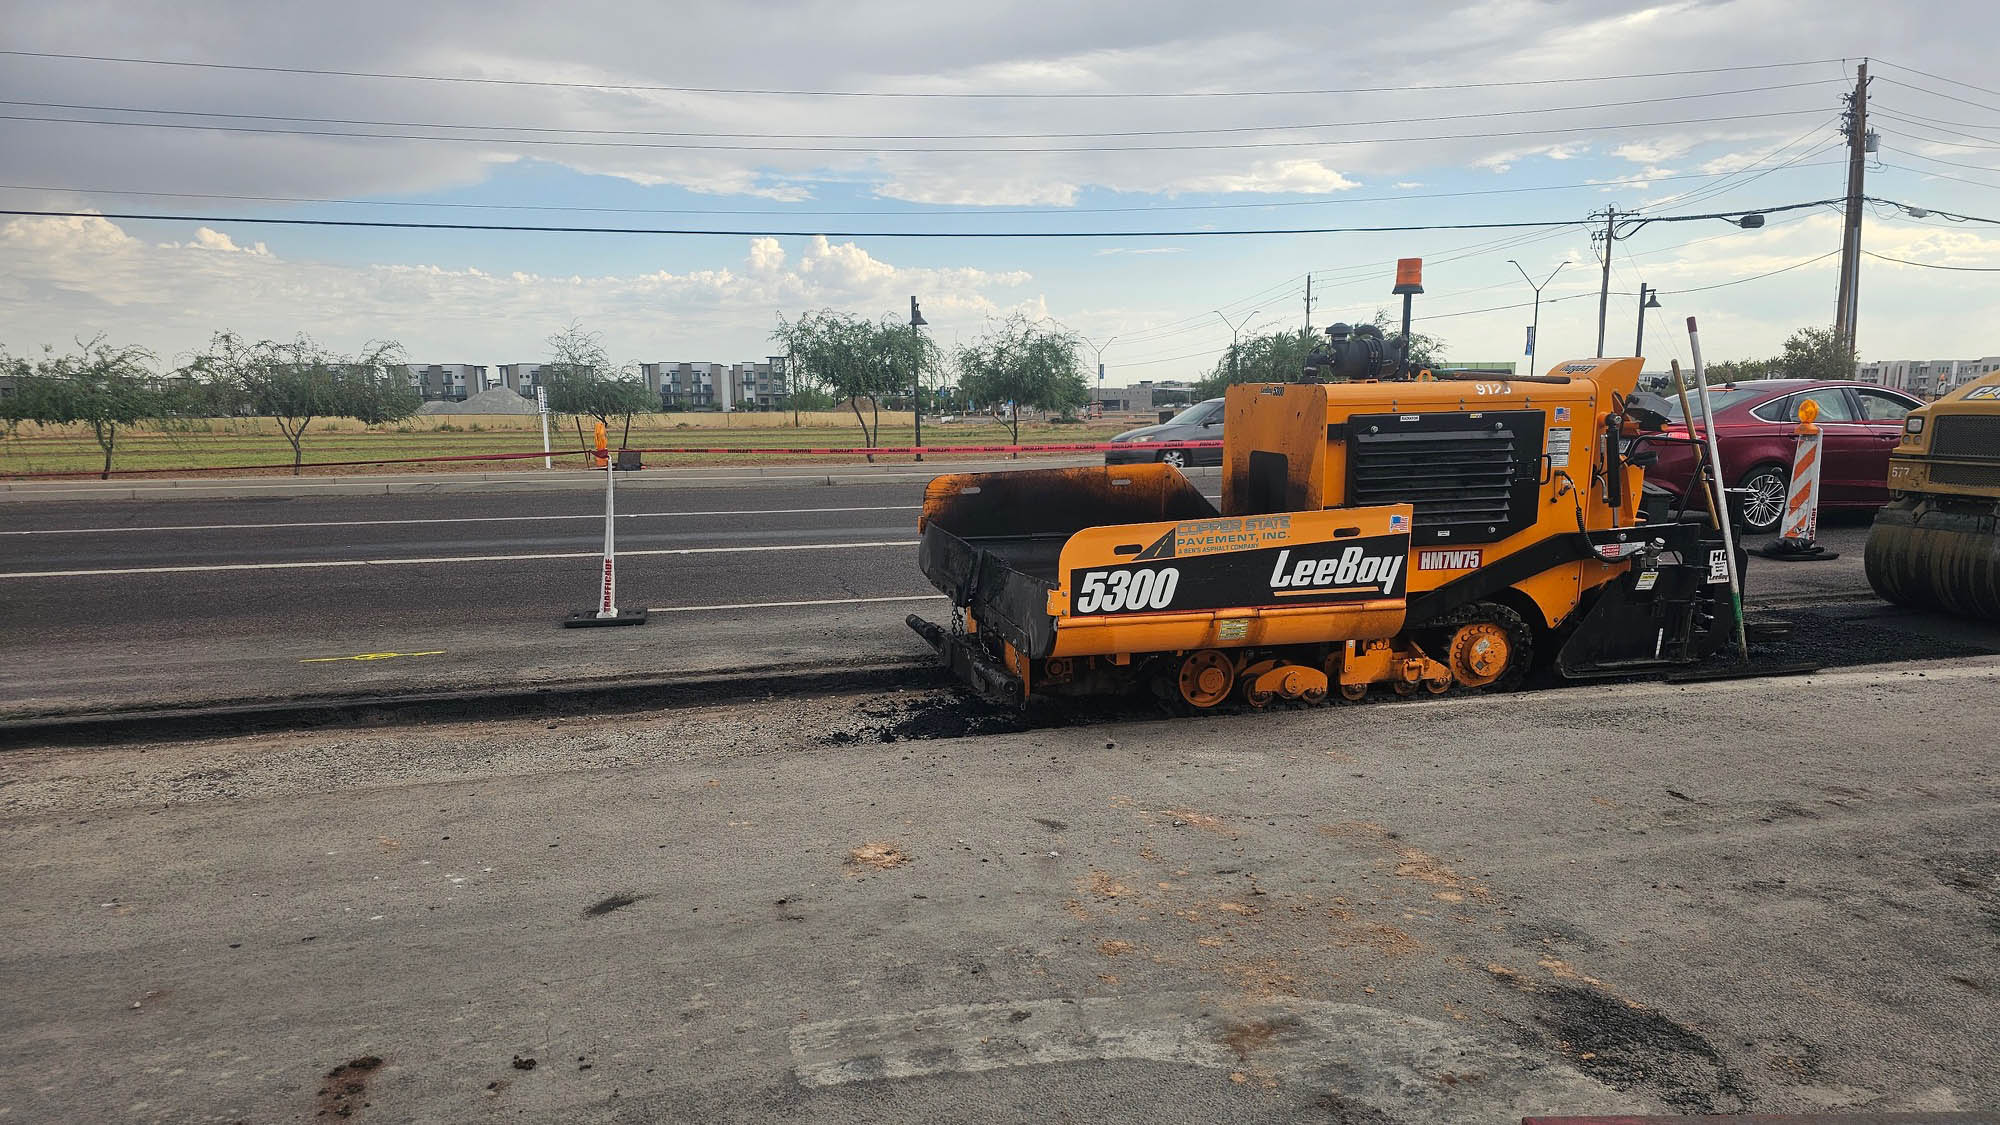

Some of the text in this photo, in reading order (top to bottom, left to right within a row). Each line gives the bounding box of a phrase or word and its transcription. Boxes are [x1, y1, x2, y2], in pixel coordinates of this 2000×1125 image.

[1966, 386, 2000, 400] CA
[1177, 516, 1291, 536] COPPER STATE
[1177, 531, 1291, 546] PAVEMENT, INC.
[1202, 544, 1229, 553] ASPHALT
[1231, 543, 1260, 551] COMPANY
[1420, 550, 1480, 570] HM7W75
[1269, 546, 1404, 595] LeeBoy
[603, 558, 613, 613] TRAFFICADE
[1077, 567, 1180, 613] 5300
